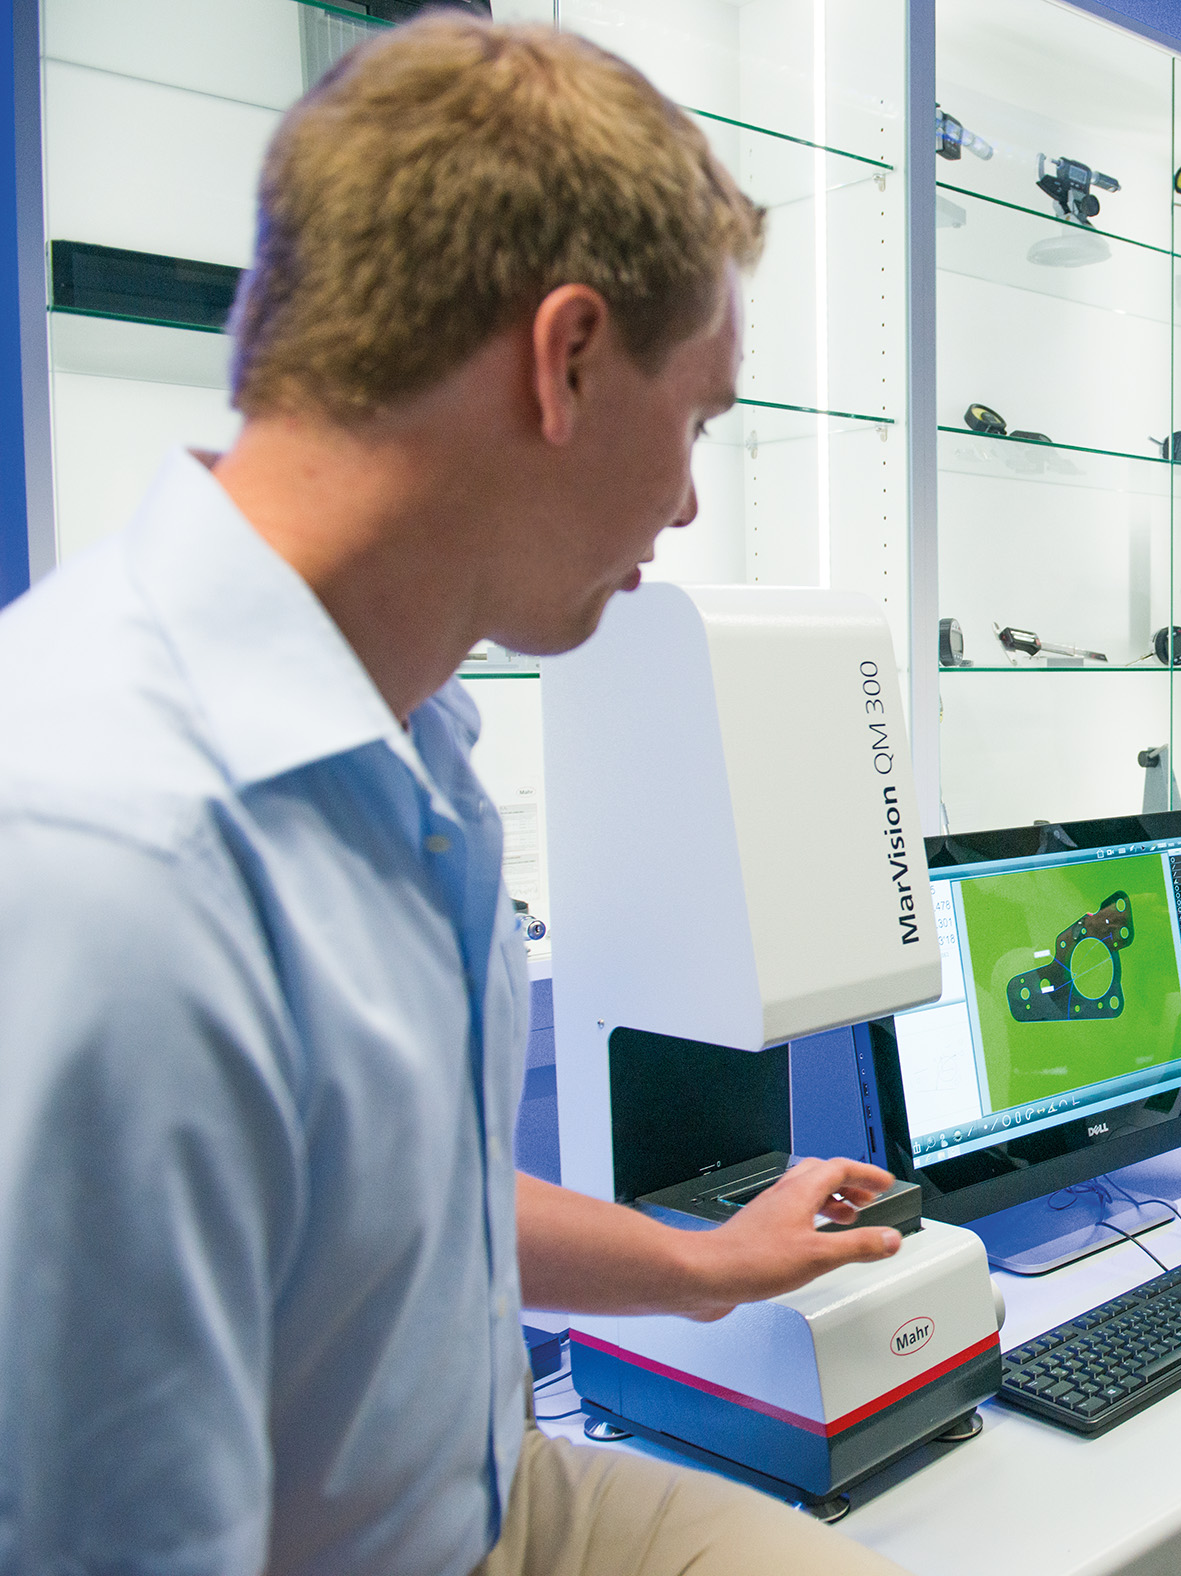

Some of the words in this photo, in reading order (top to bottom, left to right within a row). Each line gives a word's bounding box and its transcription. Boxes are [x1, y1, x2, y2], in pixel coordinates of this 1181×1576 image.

[859, 661, 884, 714] 300
[868, 723, 894, 775] QM
[883, 786, 920, 945] MarVision
[1088, 1123, 1109, 1137] DELL
[896, 1325, 929, 1351] Mahr
